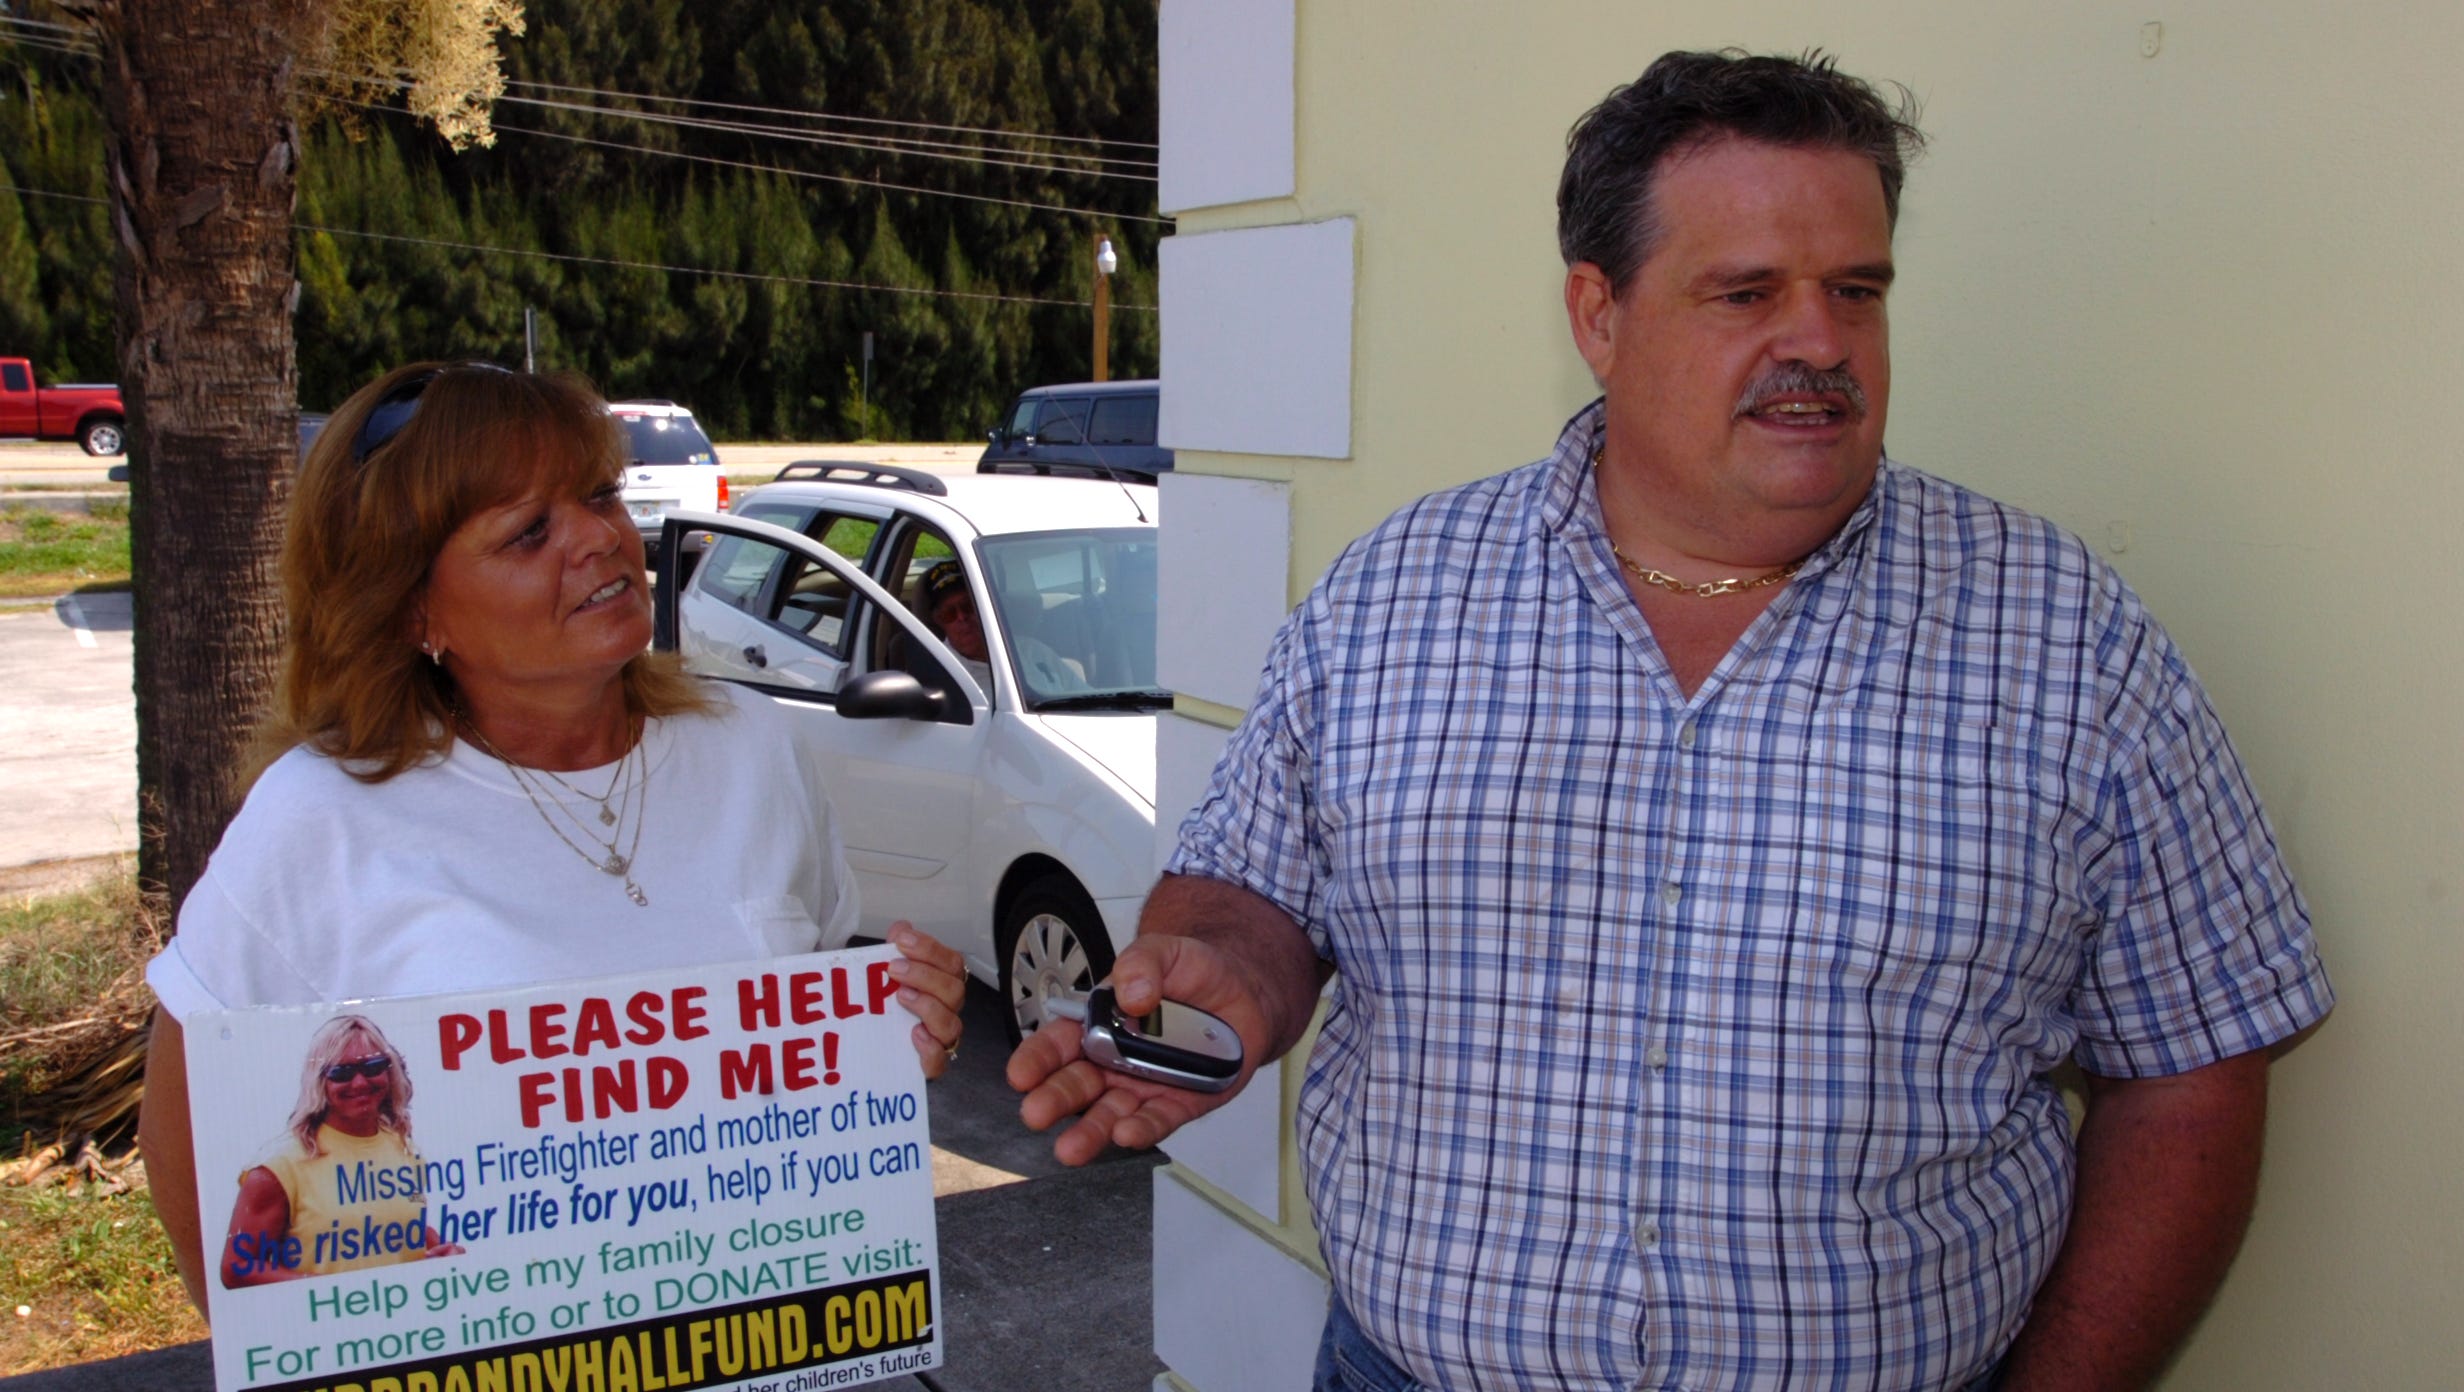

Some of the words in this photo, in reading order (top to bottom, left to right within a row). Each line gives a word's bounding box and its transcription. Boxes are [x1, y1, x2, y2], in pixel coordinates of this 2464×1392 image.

[438, 986, 710, 1071] PLEASE
[737, 961, 900, 1032] HELP
[518, 1056, 690, 1128] FIND
[719, 1031, 841, 1100] ME!
[336, 1154, 466, 1206] Missing
[476, 1130, 640, 1186] Firefighter
[650, 1113, 707, 1160] and
[717, 1103, 822, 1150] mother
[831, 1091, 858, 1132] of
[866, 1090, 917, 1127] two
[230, 1230, 302, 1278] She
[314, 1207, 427, 1265] risked
[440, 1203, 498, 1245] her
[508, 1190, 560, 1235] life
[569, 1179, 618, 1225] for
[627, 1177, 698, 1227] you,
[707, 1158, 772, 1206] help
[781, 1150, 798, 1191] if
[807, 1152, 860, 1198] you
[869, 1142, 921, 1177] can
[308, 1279, 409, 1322] Help
[424, 1267, 511, 1312] give
[526, 1254, 585, 1289] my
[598, 1229, 716, 1275] family
[729, 1208, 866, 1252] closure
[245, 1345, 321, 1382] For
[336, 1325, 446, 1367] more
[461, 1306, 536, 1346] info
[550, 1300, 591, 1330] or
[602, 1290, 641, 1320] to
[654, 1252, 830, 1312] DONATE
[842, 1238, 924, 1277] visit:
[303, 1280, 928, 1392] NDYHALLFUND.COM
[786, 1362, 875, 1392] children's
[880, 1349, 933, 1378] future
